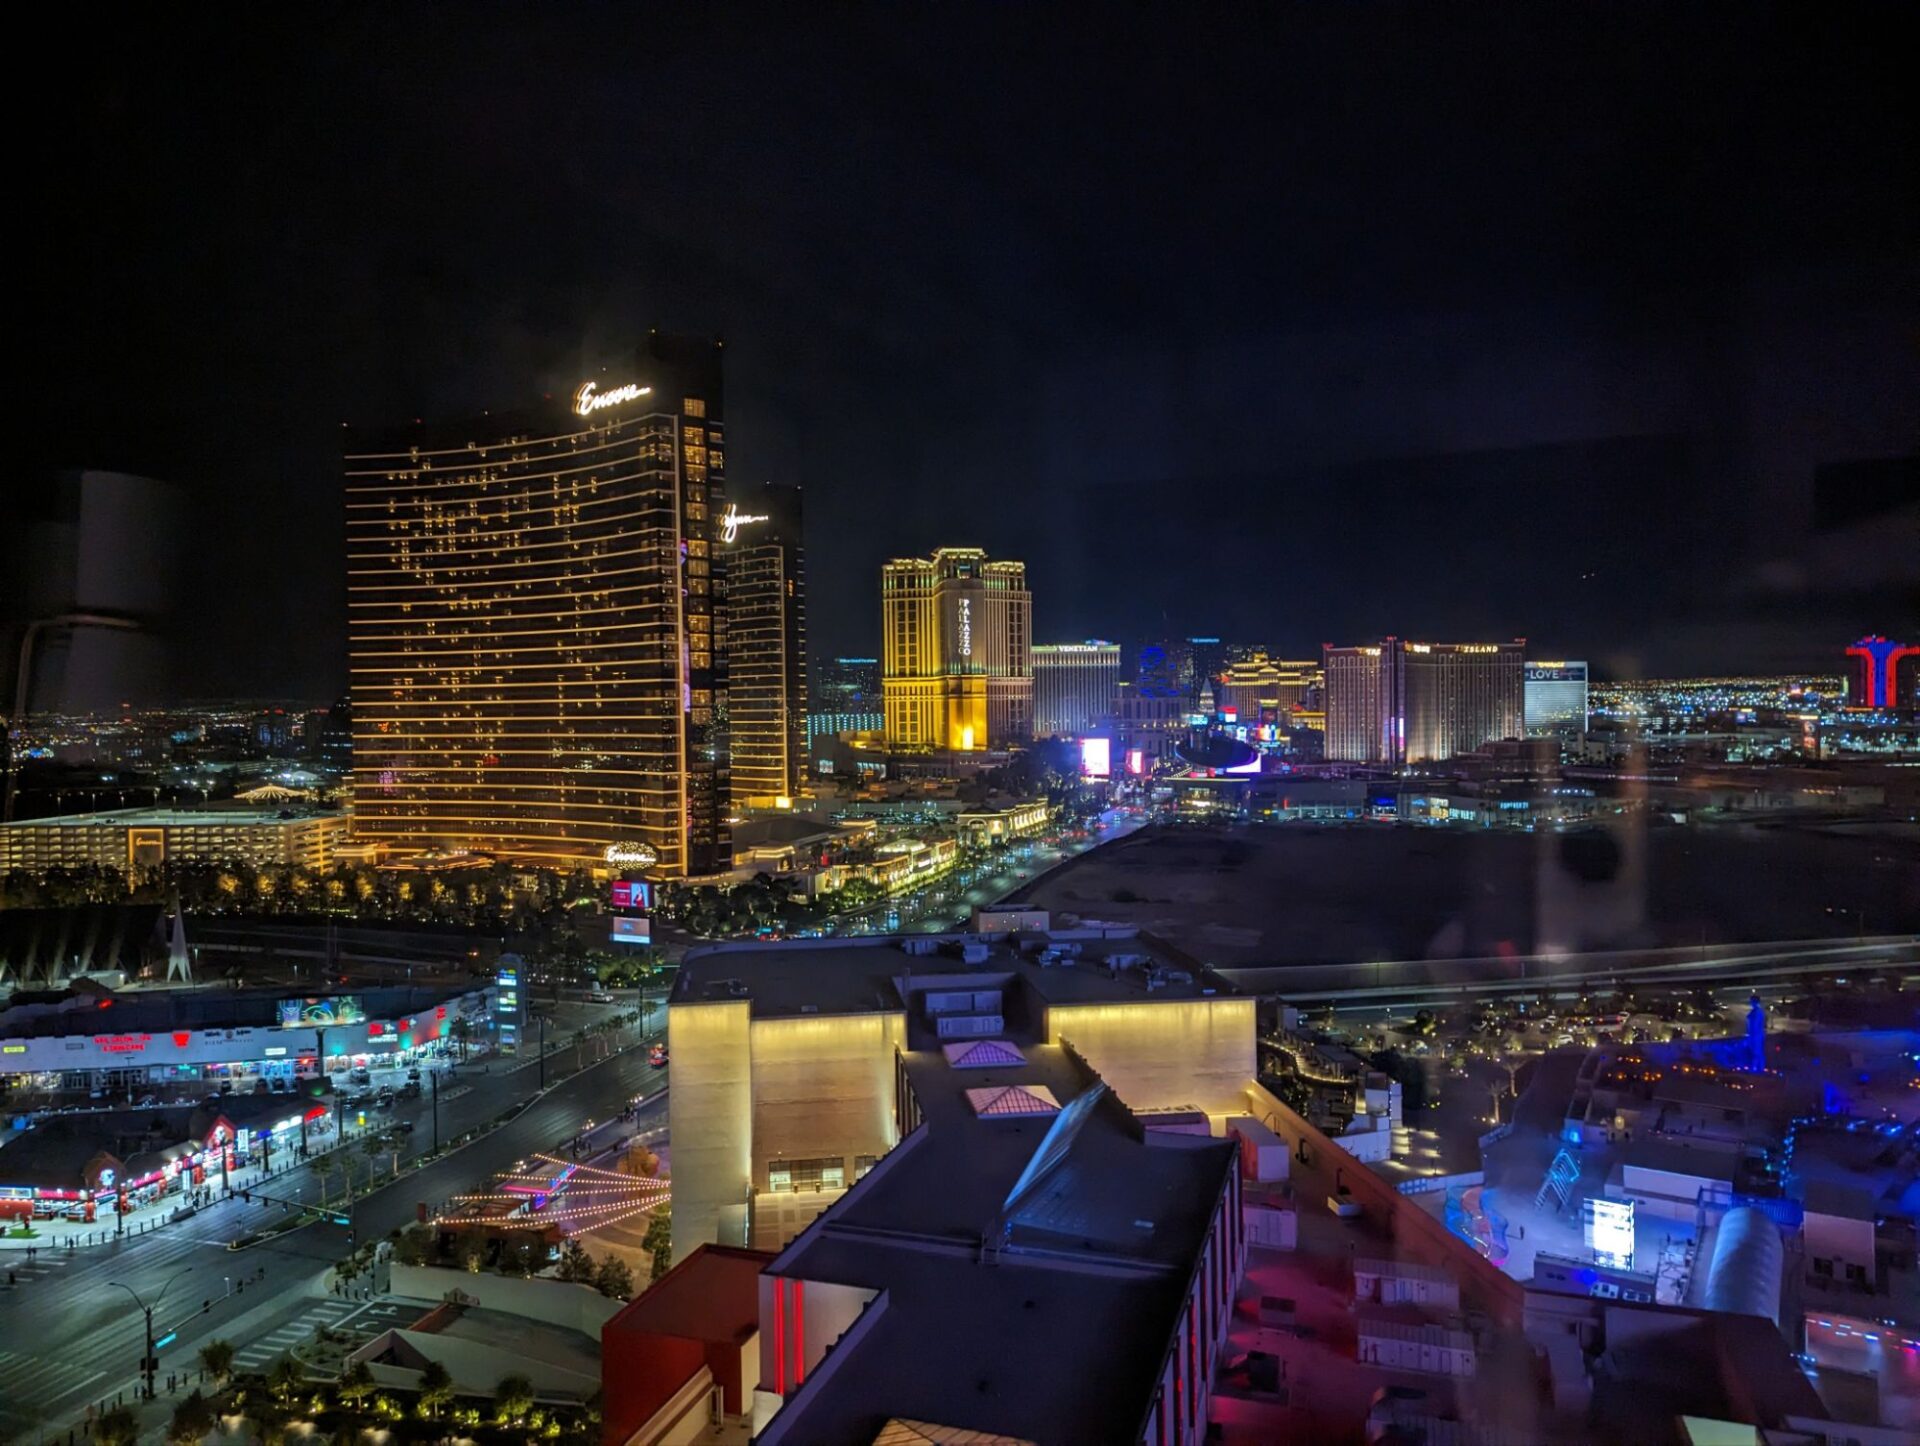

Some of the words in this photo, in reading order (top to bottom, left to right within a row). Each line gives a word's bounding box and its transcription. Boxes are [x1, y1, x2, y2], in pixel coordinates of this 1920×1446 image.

[576, 381, 651, 416] Encore
[963, 598, 971, 655] PALAZZO
[1463, 645, 1498, 654] ISLAND
[1530, 669, 1560, 680] LOVE
